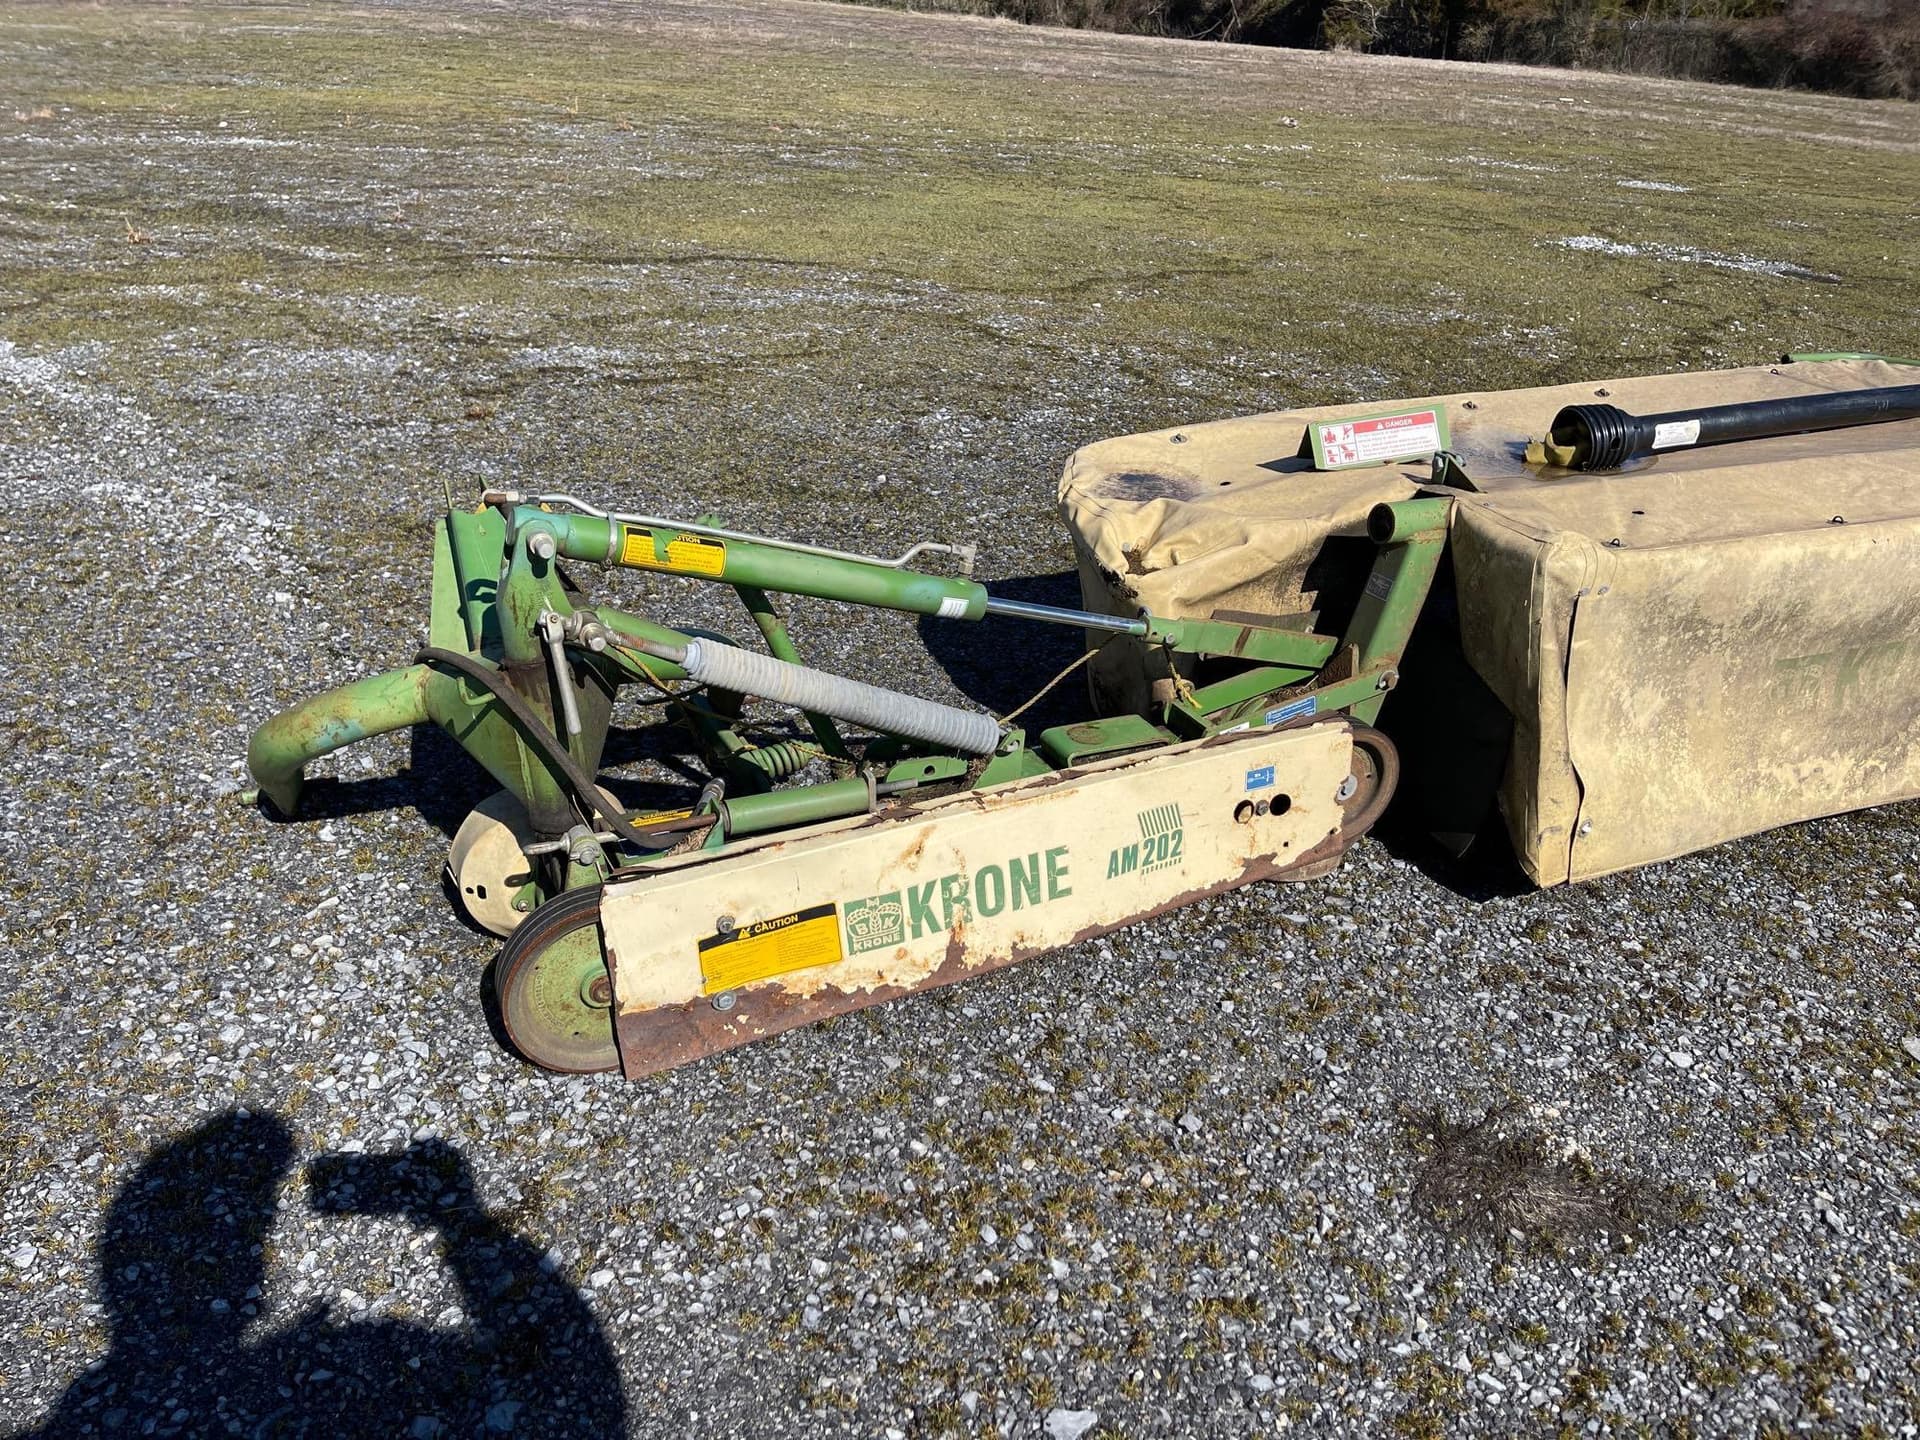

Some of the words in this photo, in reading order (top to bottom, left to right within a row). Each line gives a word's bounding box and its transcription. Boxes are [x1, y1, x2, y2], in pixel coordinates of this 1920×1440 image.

[1385, 419, 1413, 428] DANGER
[1106, 843, 1139, 880] AM
[1142, 828, 1183, 867] 202
[907, 845, 1072, 940] KRONE
[754, 914, 799, 933] CAUTION
[853, 932, 901, 952] KRONE
